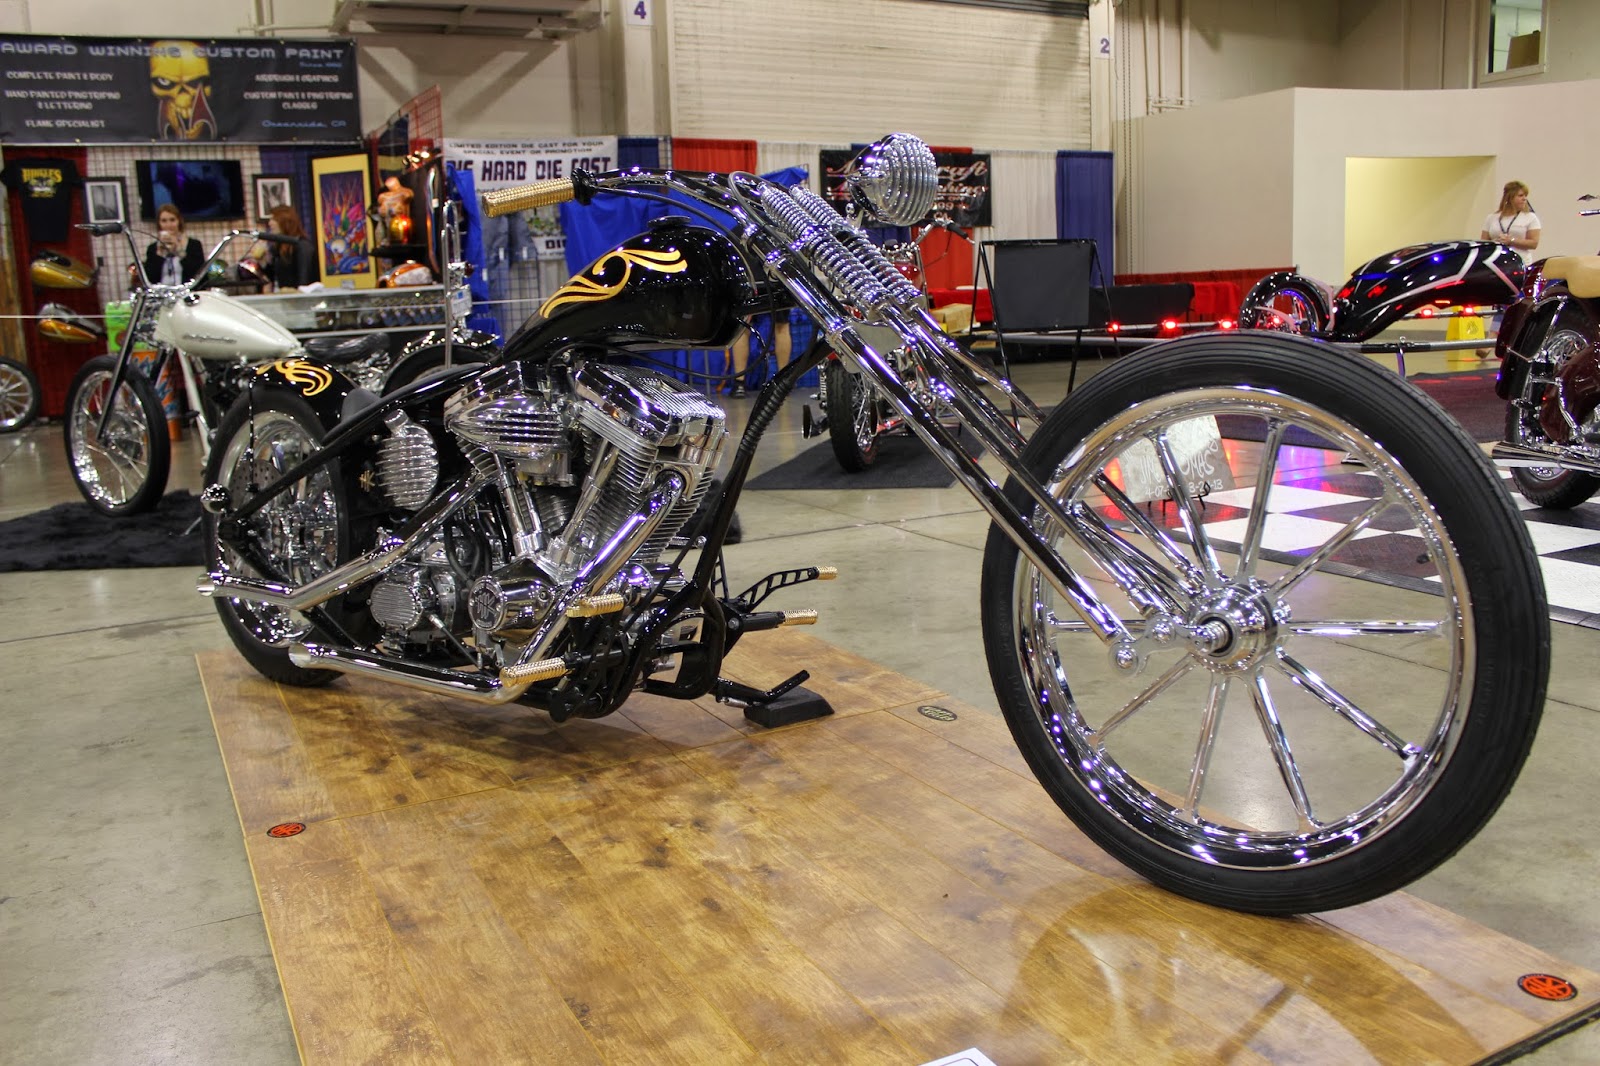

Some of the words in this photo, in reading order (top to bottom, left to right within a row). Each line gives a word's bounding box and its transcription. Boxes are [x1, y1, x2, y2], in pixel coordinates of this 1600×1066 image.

[634, 1, 647, 19] 4
[1, 42, 78, 55] AWARD
[88, 45, 181, 57] WINNING
[193, 47, 275, 58] CUSTOM
[285, 48, 344, 59] PAINT
[1100, 38, 1110, 53] 2
[481, 160, 527, 181] HARD
[536, 160, 562, 180] DIE
